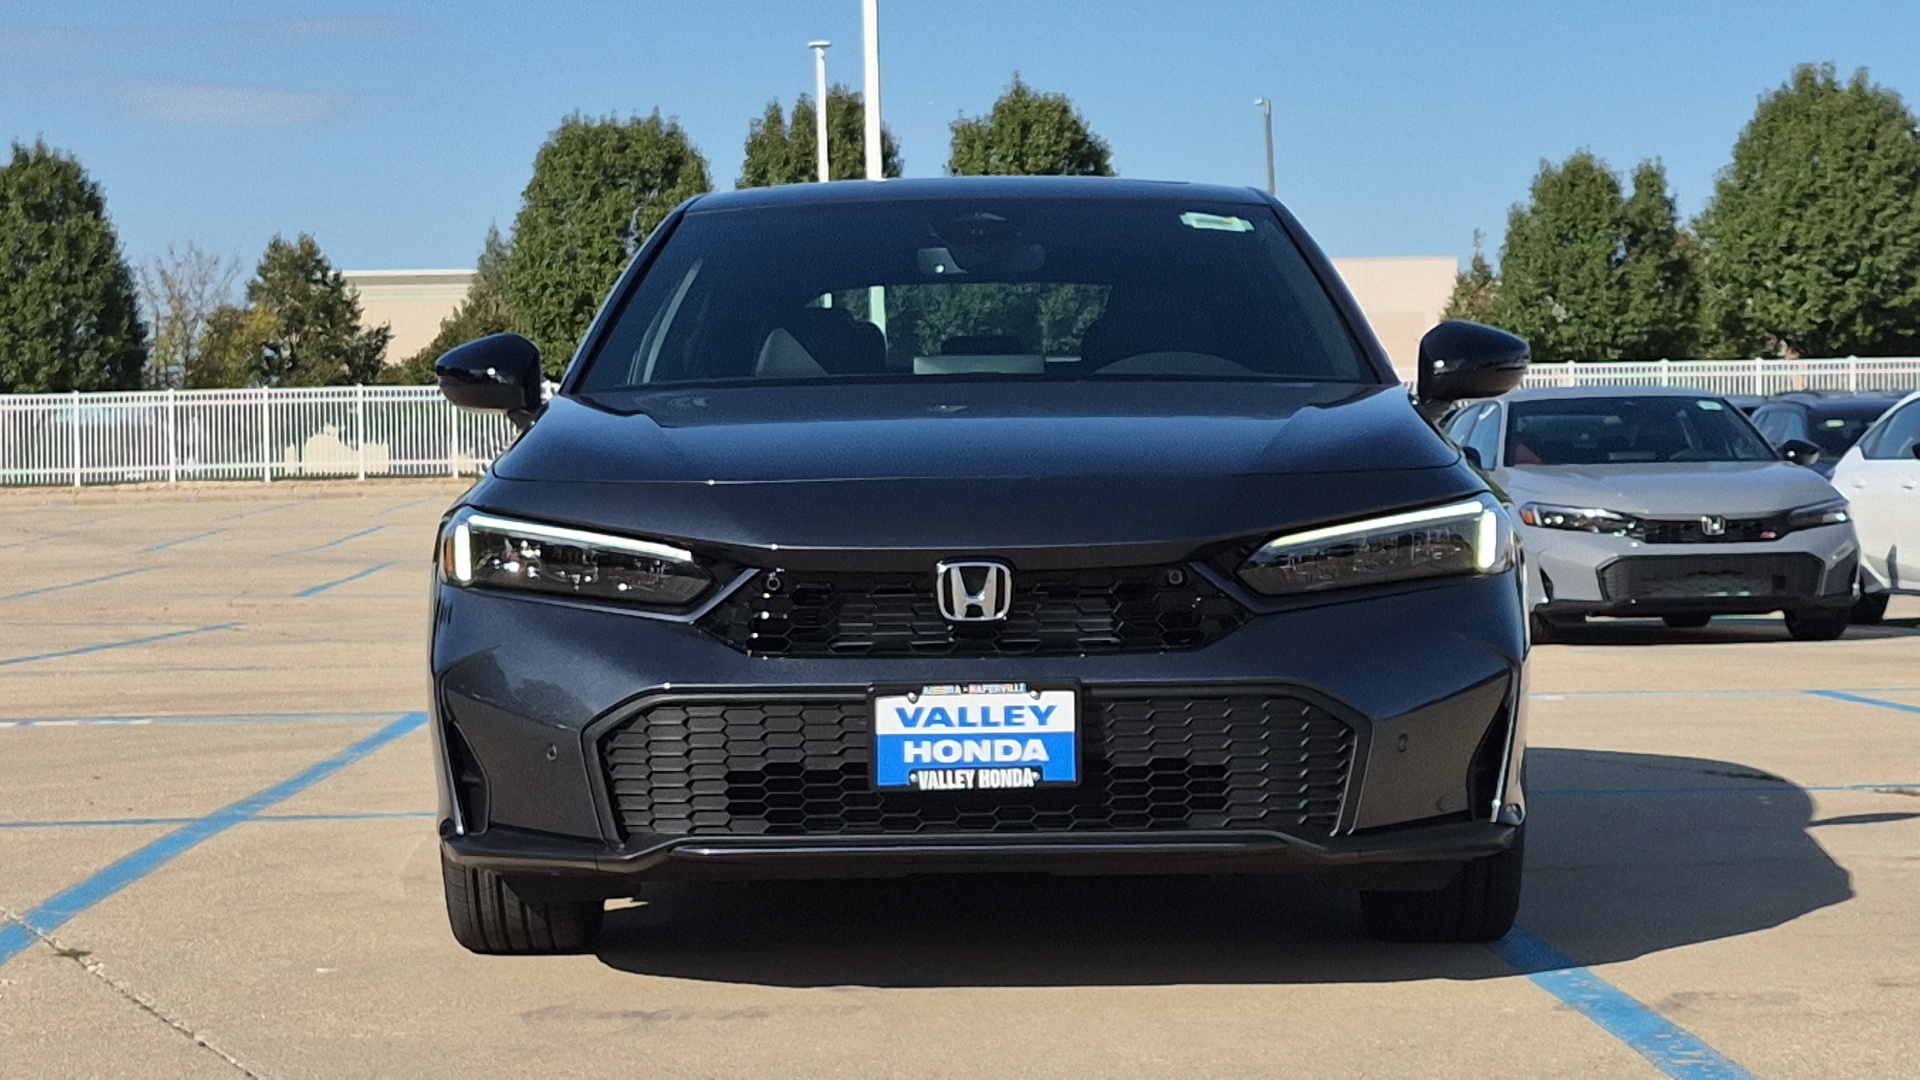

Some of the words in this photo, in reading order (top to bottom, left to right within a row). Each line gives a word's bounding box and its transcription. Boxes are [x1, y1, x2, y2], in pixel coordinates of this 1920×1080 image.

[947, 564, 1000, 620] H
[895, 705, 1057, 728] VALLEY
[903, 739, 1049, 763] HONDA
[918, 769, 975, 790] VALLEY
[978, 767, 1035, 788] HONDA
